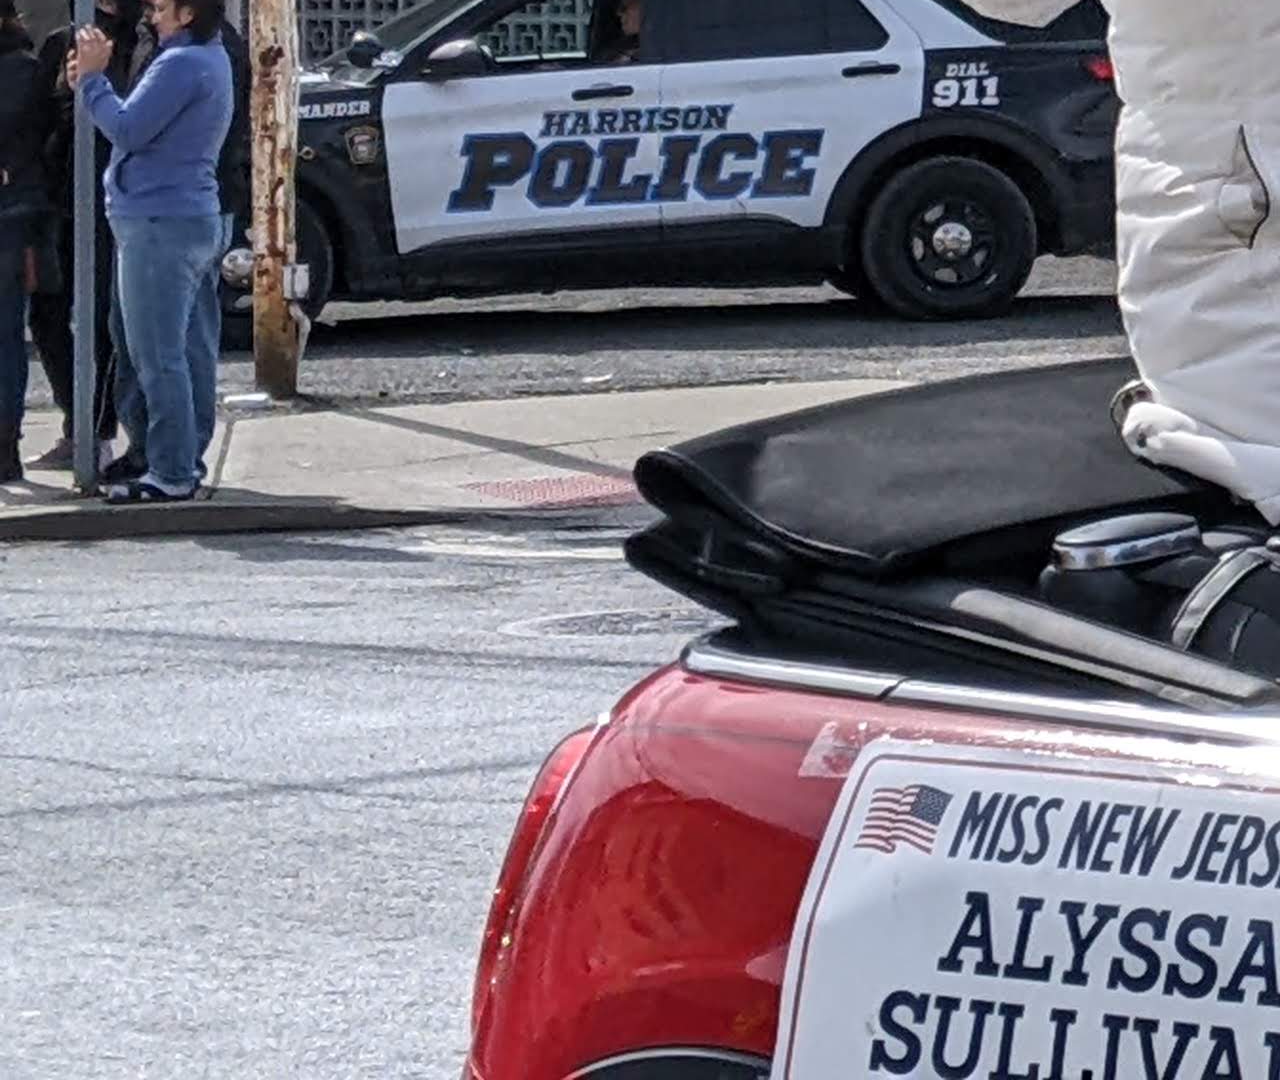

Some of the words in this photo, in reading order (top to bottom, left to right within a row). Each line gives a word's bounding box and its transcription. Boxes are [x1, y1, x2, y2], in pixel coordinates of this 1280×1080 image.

[945, 62, 990, 77] DIAL
[932, 76, 1000, 107] 911
[297, 100, 371, 119] MANDER
[538, 104, 735, 138] HARRISON
[446, 128, 826, 214] POLICE
[947, 791, 1065, 866] MISS
[1057, 796, 1180, 878] NEW
